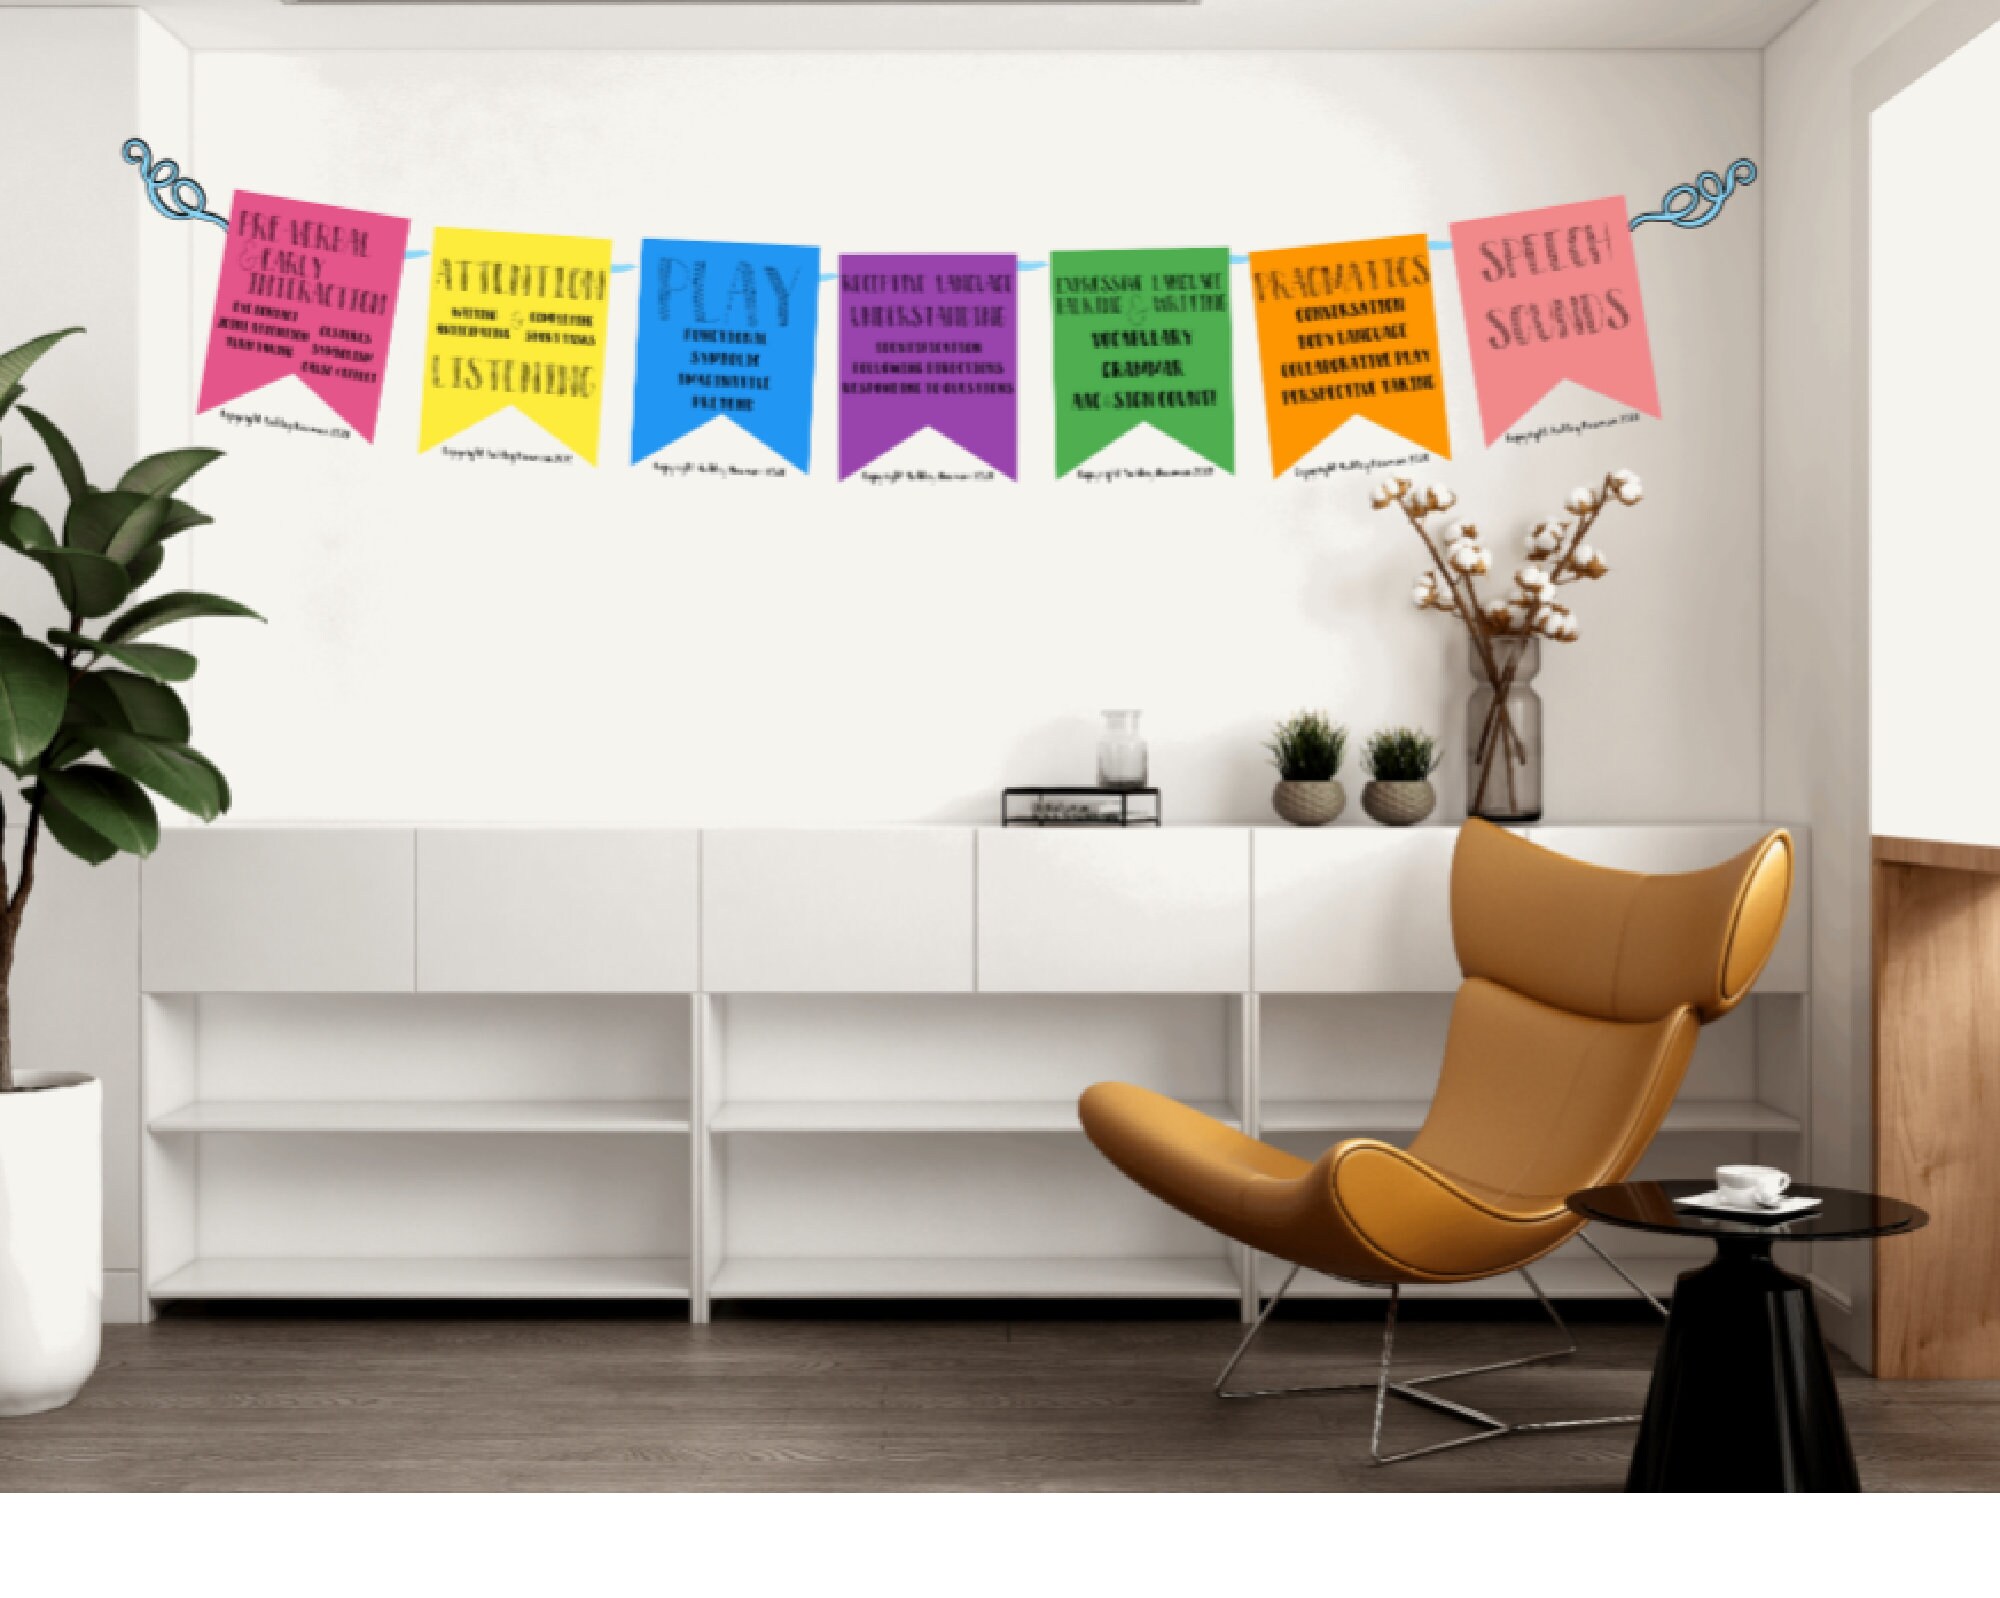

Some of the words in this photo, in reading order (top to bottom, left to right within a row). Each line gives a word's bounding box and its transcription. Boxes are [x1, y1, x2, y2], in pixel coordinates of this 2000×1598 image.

[260, 247, 325, 280] EARLY
[1478, 221, 1613, 282] SPEECH
[435, 258, 606, 300] ATTENTION
[657, 257, 802, 327] PLAY
[842, 274, 924, 294] RECEPTIVE
[936, 274, 1011, 294] LANGUAGE
[1056, 274, 1143, 294] EXPRESSIVE
[1151, 272, 1221, 291] LANGUAGE
[1254, 254, 1430, 303] PRAGMATICS
[248, 272, 388, 315] INTERACTION
[850, 305, 1004, 328] UNDERSTANDING
[1056, 296, 1121, 315] TALKING
[1127, 294, 1147, 326] &
[1153, 293, 1225, 313] WRITING
[1295, 297, 1405, 323] CONVERSATION
[1485, 288, 1631, 350] SOUNDS
[683, 328, 767, 345] FUNCTIONAL
[1091, 329, 1193, 349] VOCABULARY
[1298, 332, 1334, 350] BODY
[1337, 322, 1406, 345] LANGUAGE
[690, 351, 760, 367] SYMBOLIC
[852, 361, 923, 375] FOLLOWING
[926, 361, 1005, 375] DIRECTIONS
[1101, 359, 1185, 379] GRAMMAR
[1280, 351, 1391, 378] COLLABORATIVE
[1393, 349, 1430, 367] PLAY
[432, 354, 595, 399] LISTENING
[678, 372, 771, 390] IMAGINATIVE
[942, 382, 1015, 395] QUESTIONS
[1281, 381, 1375, 406] PERSPECTIVE
[1381, 374, 1435, 394] TAKING
